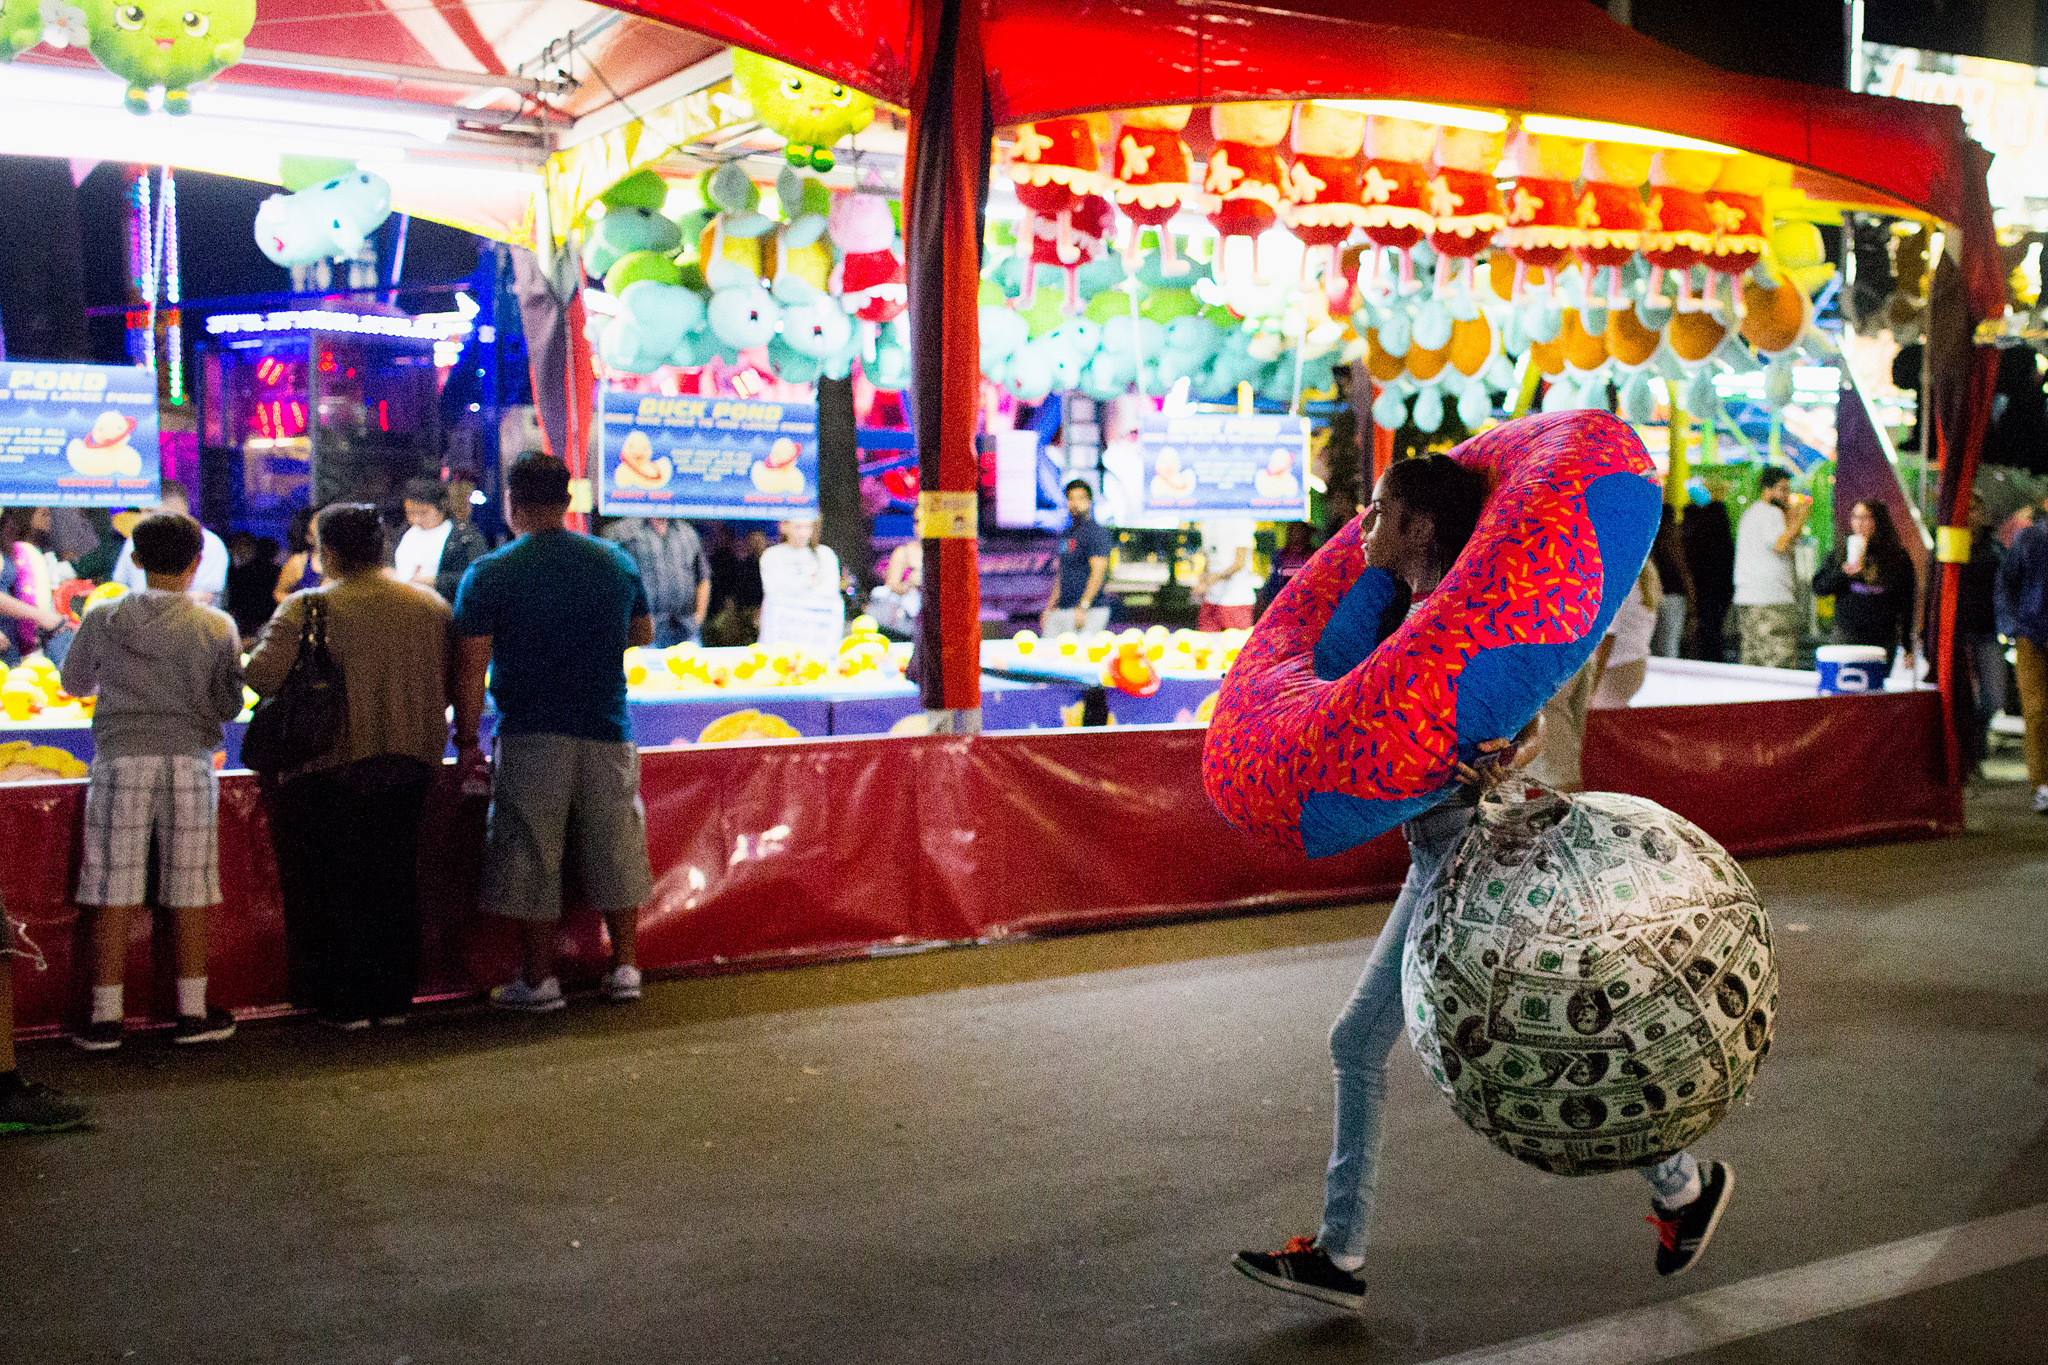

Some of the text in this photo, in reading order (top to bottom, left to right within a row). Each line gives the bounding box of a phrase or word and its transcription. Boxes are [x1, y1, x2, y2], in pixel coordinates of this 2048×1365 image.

[8, 370, 107, 390] POND
[638, 397, 783, 422] DUCK POND
